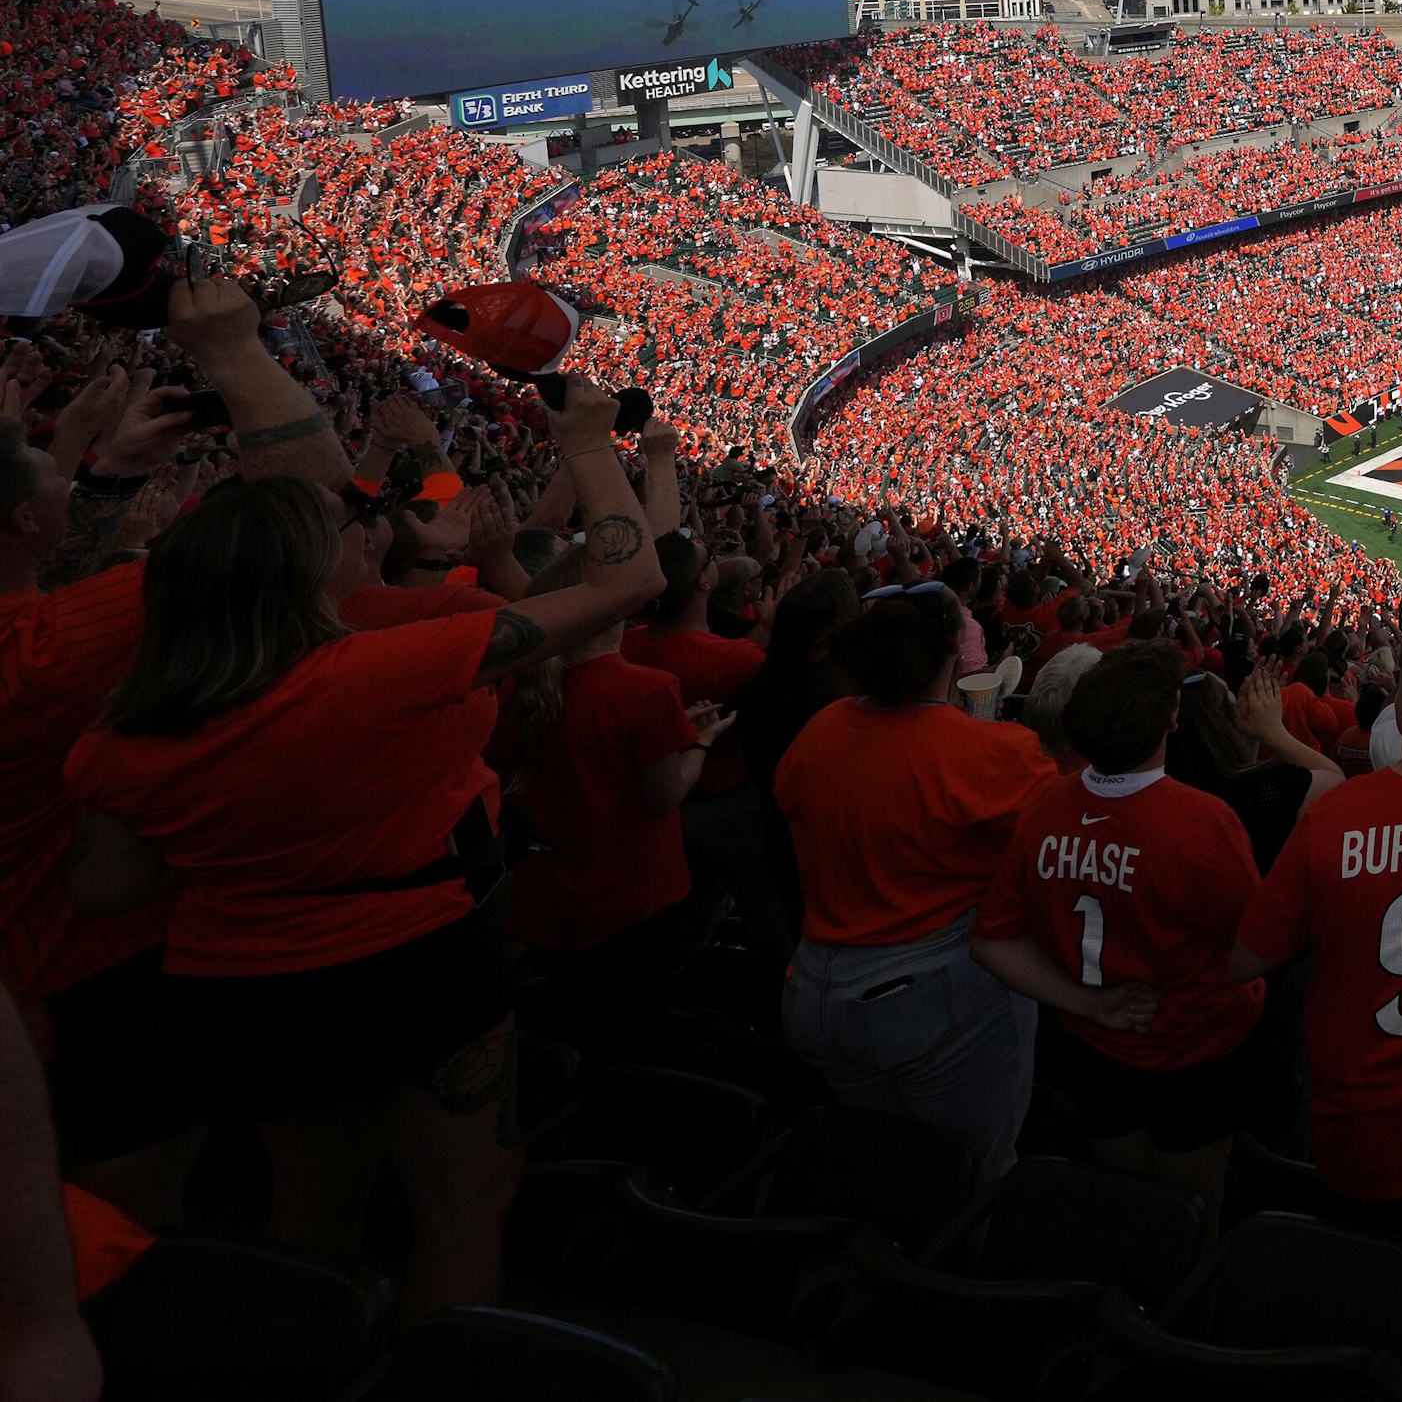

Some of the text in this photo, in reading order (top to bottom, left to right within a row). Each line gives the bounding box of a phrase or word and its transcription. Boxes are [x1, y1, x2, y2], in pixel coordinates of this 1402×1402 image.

[619, 65, 706, 91] Kettering
[502, 83, 589, 104] FIFTH THIRD
[645, 82, 696, 99] HEALTH
[503, 102, 545, 117] BANK
[1279, 208, 1304, 219] Paycor
[1313, 199, 1338, 210] Paycor
[1100, 247, 1145, 267] HYUNDAI
[1163, 381, 1214, 408] Kroger
[1086, 773, 1125, 784] NIKE PRO
[1037, 834, 1141, 893] CHASE
[1072, 894, 1106, 987] 1
